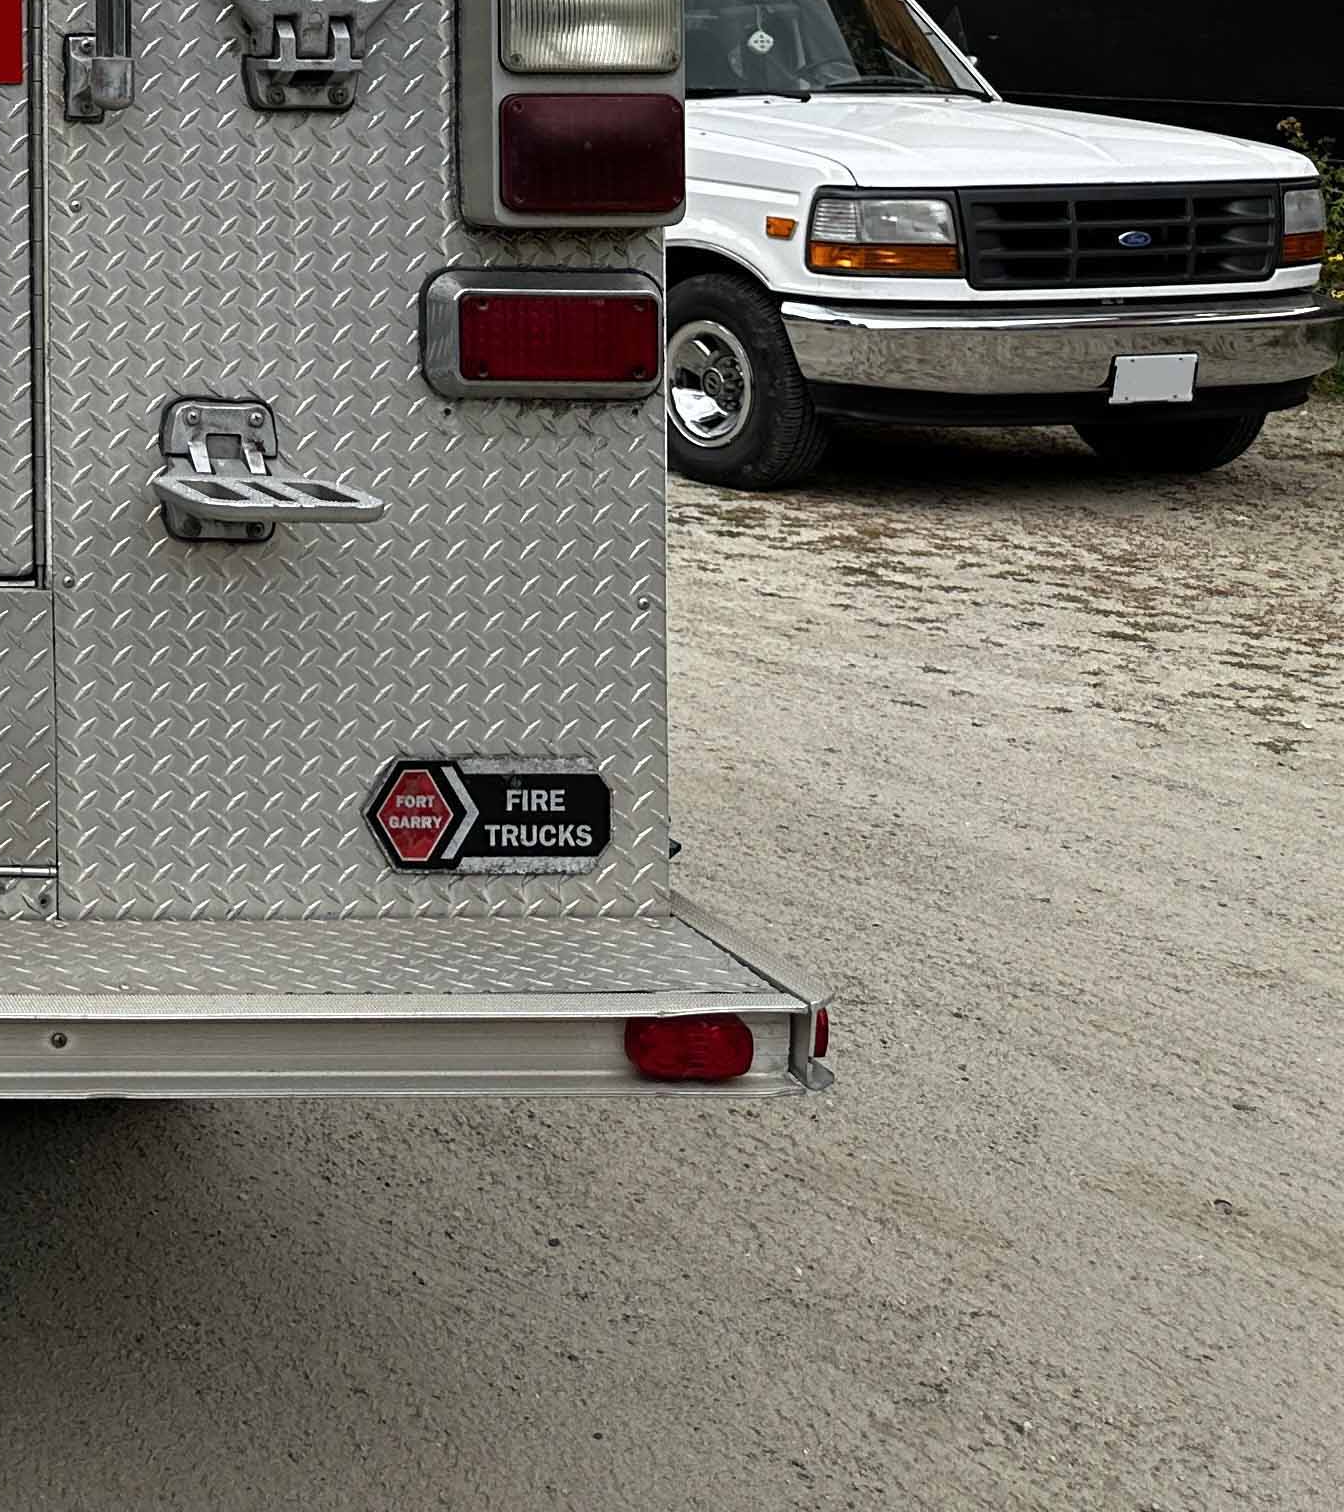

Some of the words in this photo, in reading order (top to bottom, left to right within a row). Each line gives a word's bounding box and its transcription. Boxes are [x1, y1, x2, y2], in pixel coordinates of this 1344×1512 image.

[396, 795, 435, 808] FORT
[506, 789, 566, 812] FIRE
[388, 816, 442, 829] GARRY
[484, 824, 593, 847] TRUCKS
